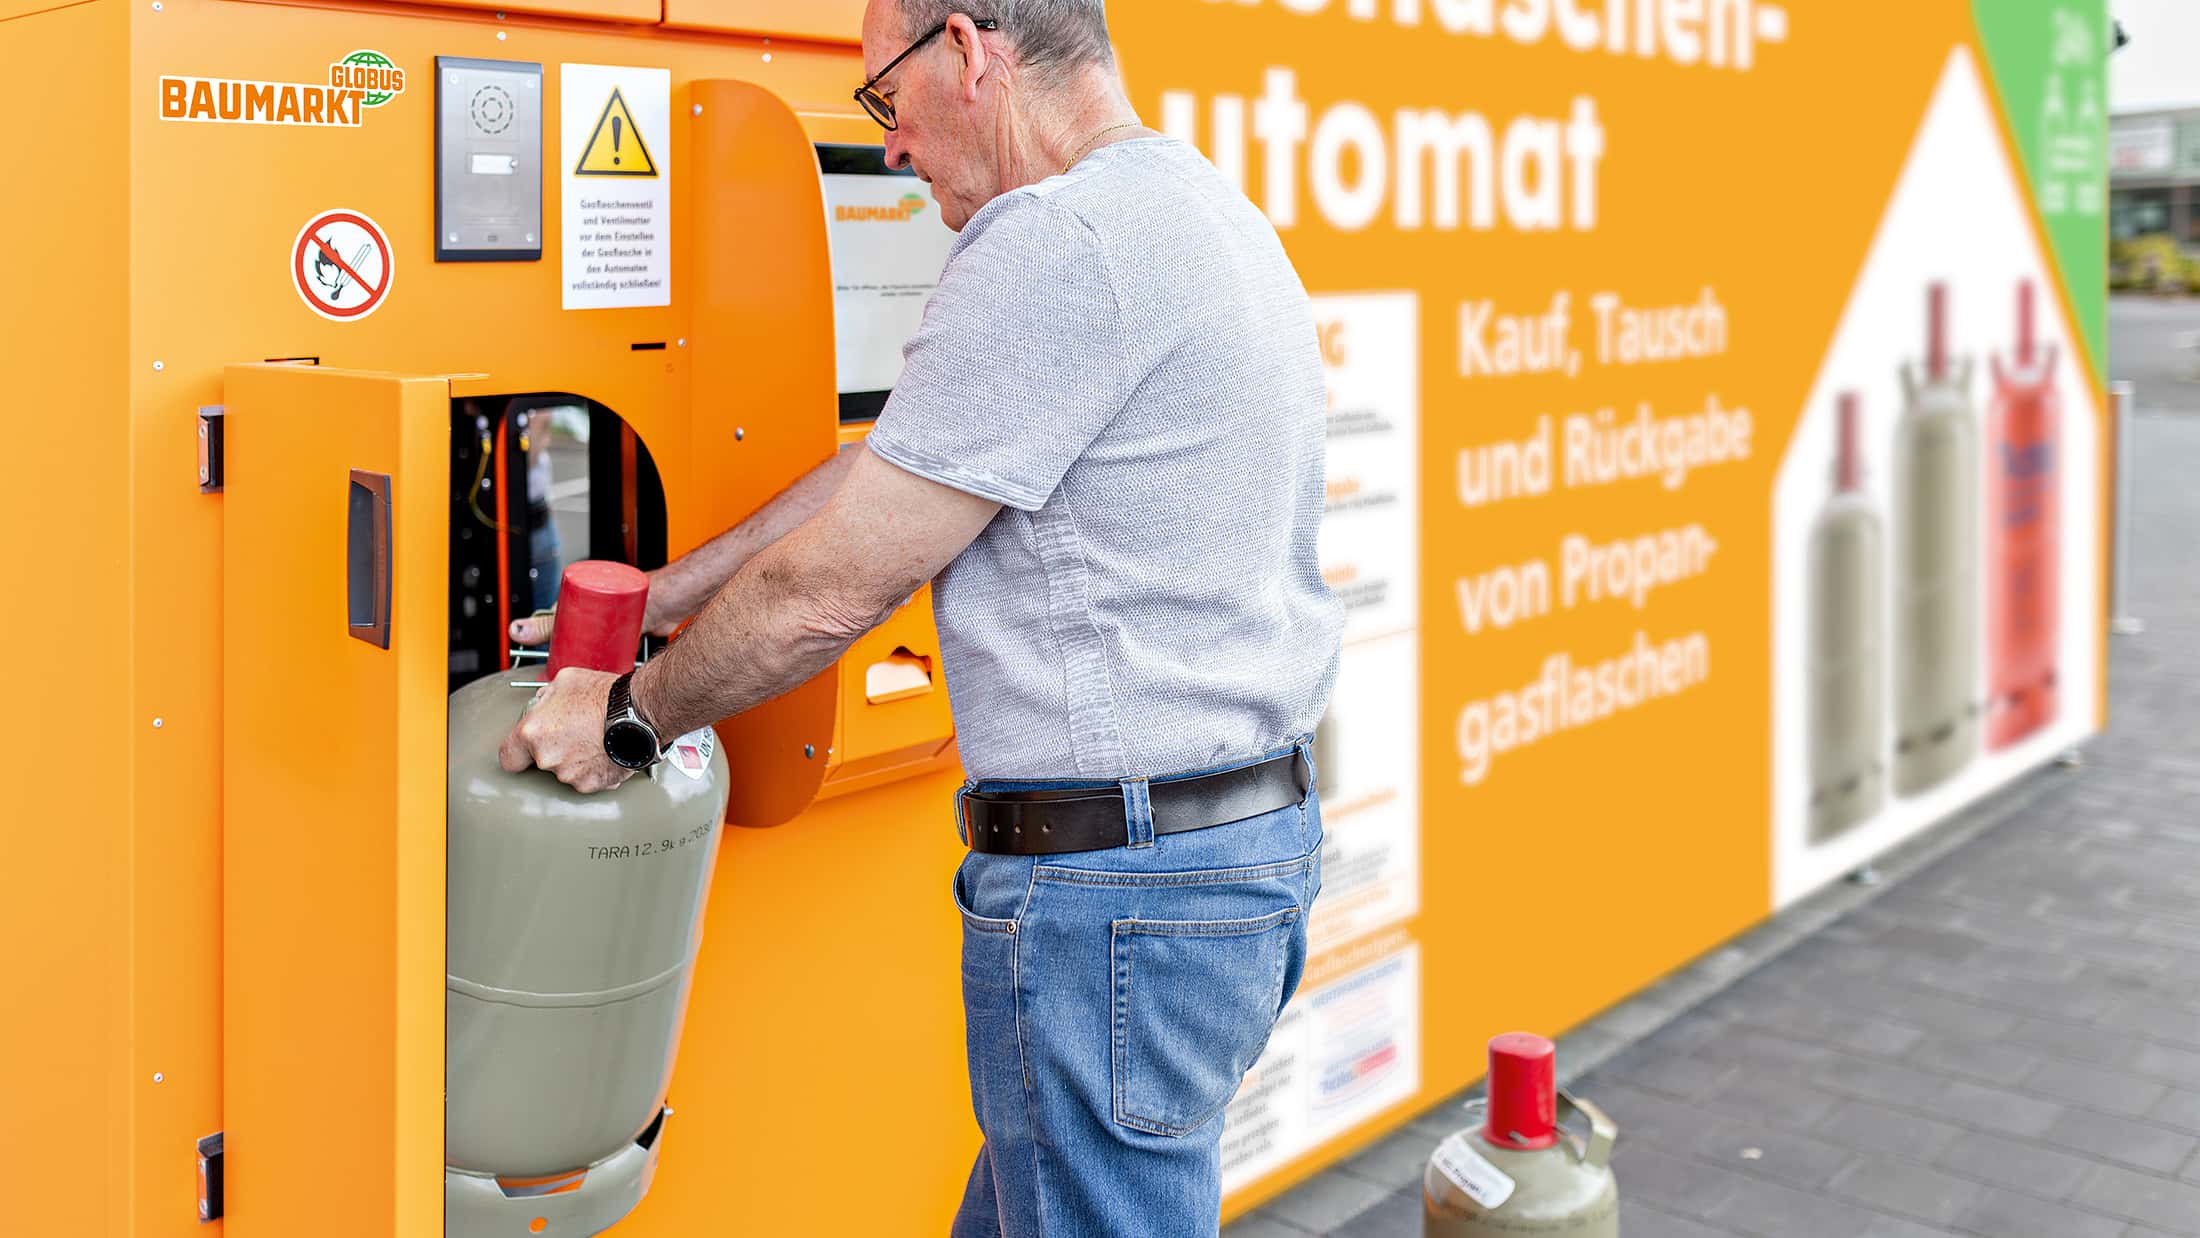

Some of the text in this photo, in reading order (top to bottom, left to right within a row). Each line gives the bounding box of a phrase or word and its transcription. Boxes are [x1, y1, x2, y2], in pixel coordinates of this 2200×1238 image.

[162, 78, 365, 125] BAUMARKT
[331, 66, 403, 91] GLOBUS
[1458, 285, 1727, 378] Kauf, Tausch
[1458, 392, 1752, 506] und Rückgabe
[1457, 523, 1717, 635] von Propan-
[1458, 631, 1709, 784] gasflaschen
[588, 845, 630, 859] TARA
